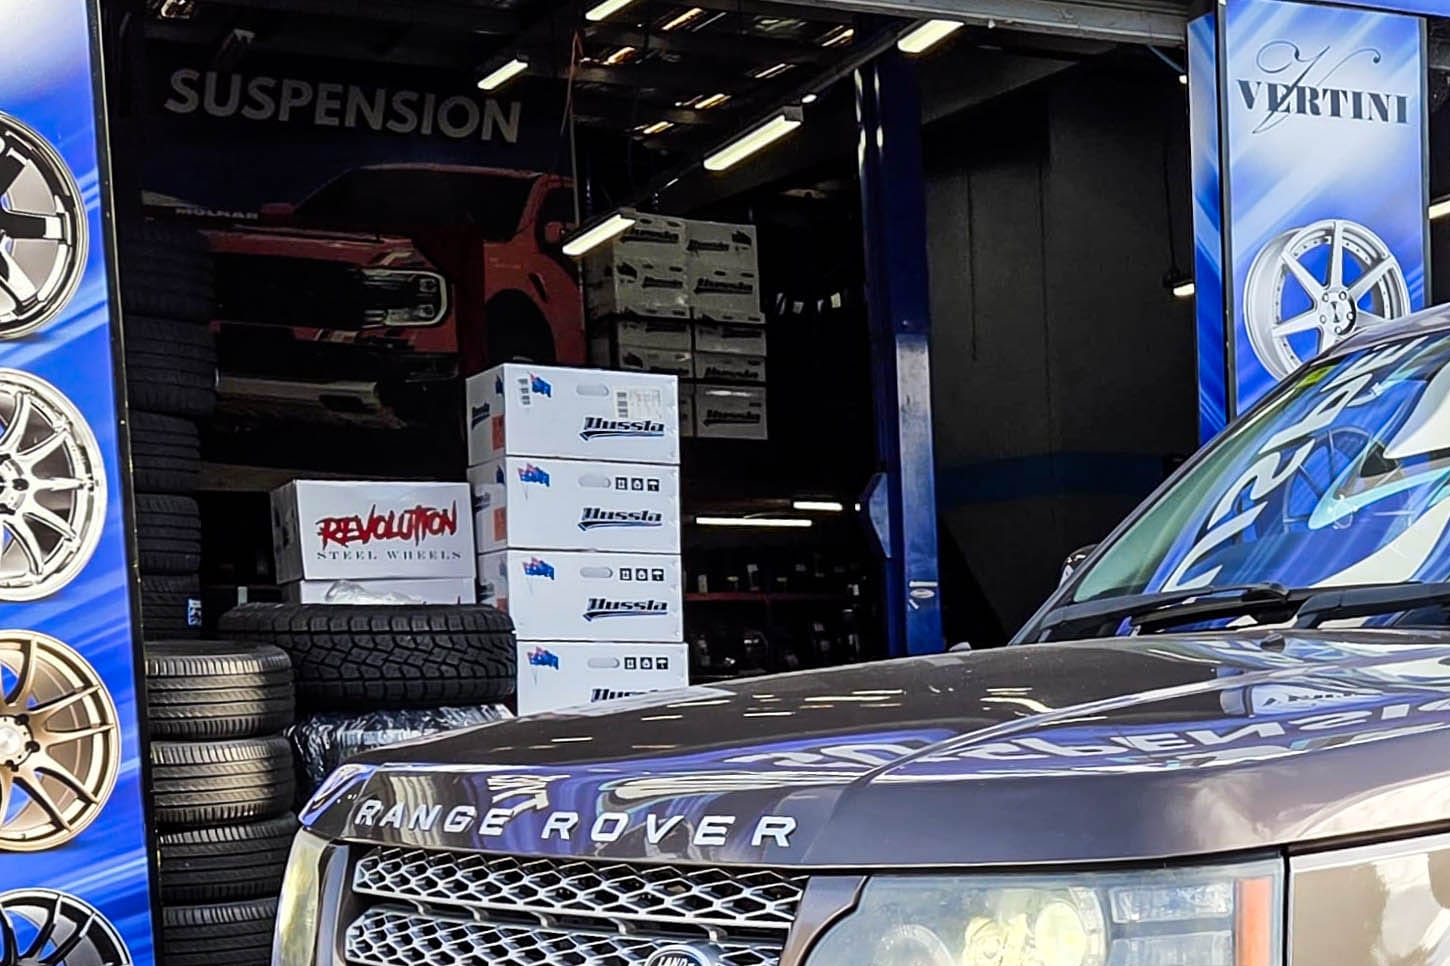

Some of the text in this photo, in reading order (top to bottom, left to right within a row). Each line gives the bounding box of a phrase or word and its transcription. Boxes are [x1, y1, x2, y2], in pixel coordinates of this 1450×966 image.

[163, 68, 522, 144] SUSPENSION
[1236, 78, 1409, 125] VERTINI
[315, 500, 457, 551] REVOLUTION
[316, 551, 462, 560] STEEL WHEELS
[353, 799, 798, 848] RANGE ROVER
